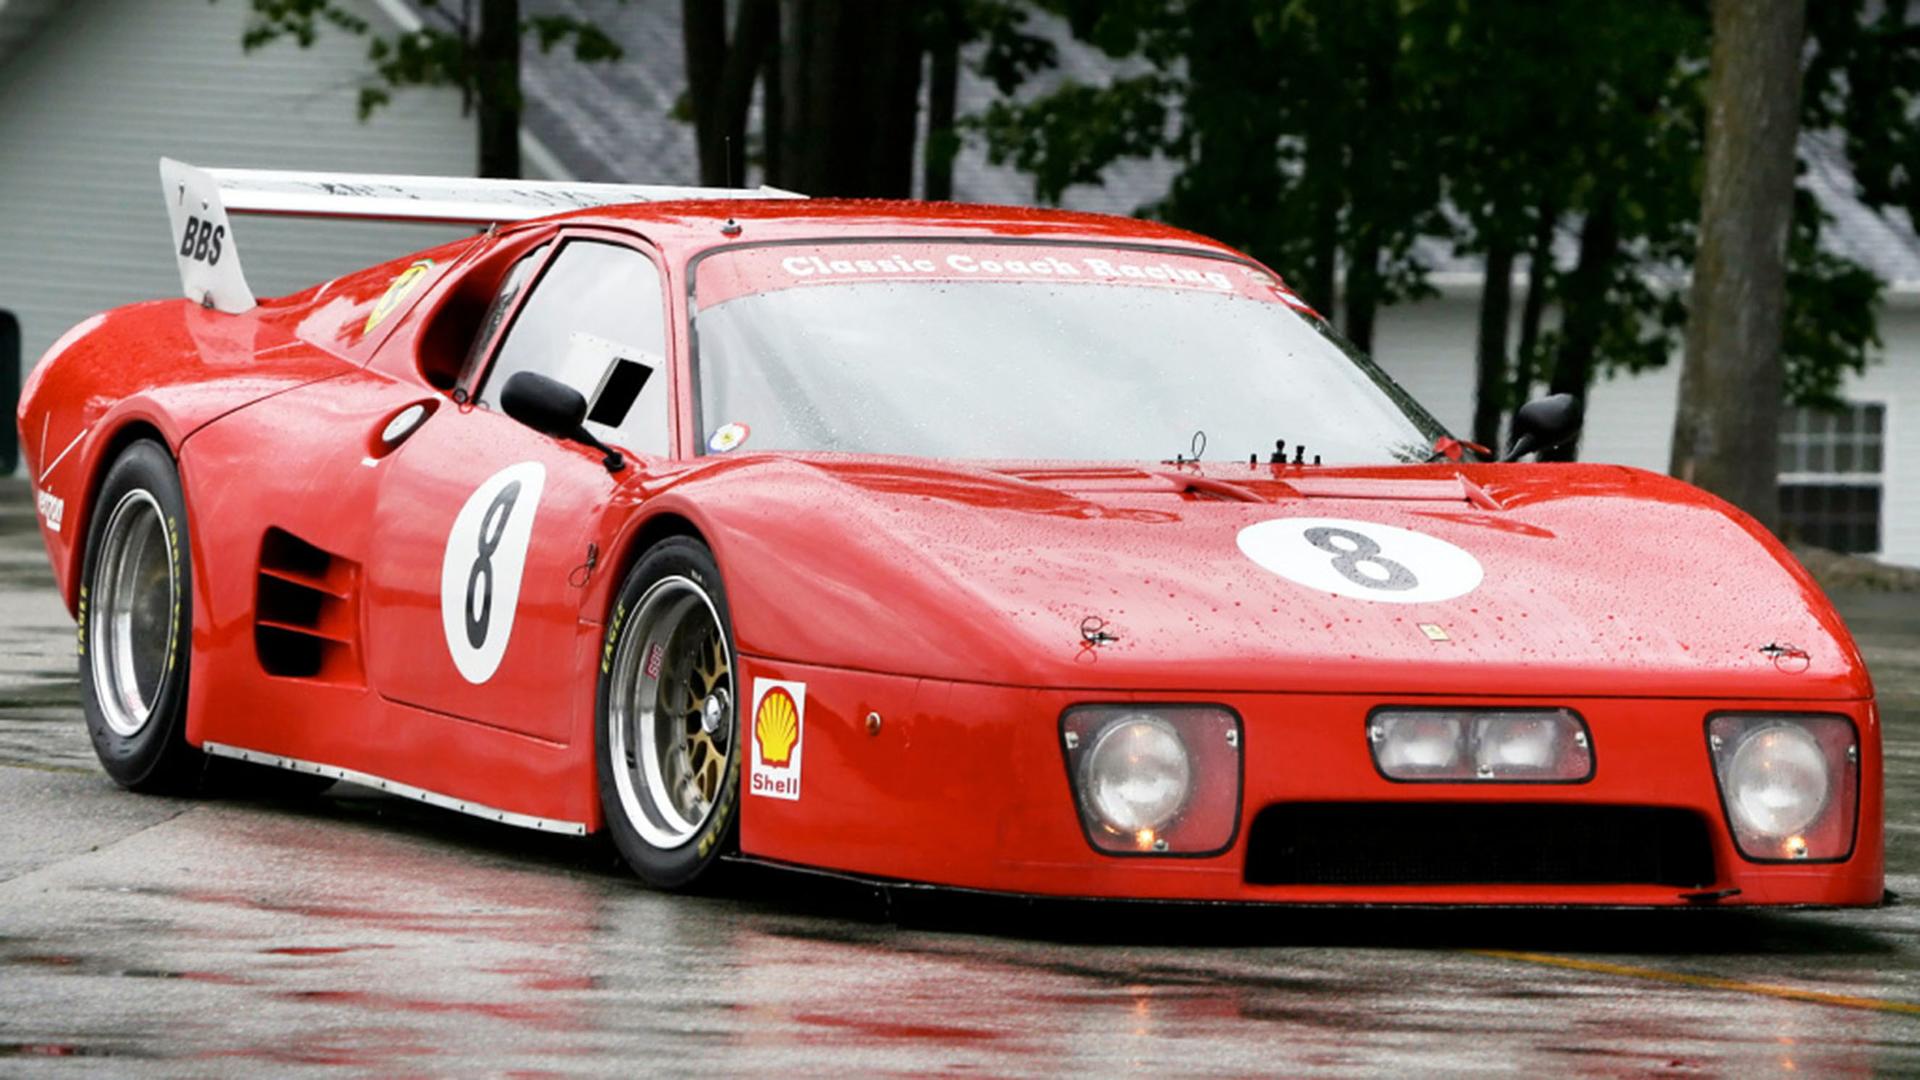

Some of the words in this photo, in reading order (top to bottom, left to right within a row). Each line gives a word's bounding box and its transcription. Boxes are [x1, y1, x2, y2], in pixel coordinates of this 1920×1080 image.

[180, 216, 224, 267] BBS
[782, 254, 936, 276] Classic
[946, 254, 1080, 275] Coach
[1083, 258, 1232, 290] Racing
[465, 480, 522, 649] 8
[1303, 526, 1419, 591] 8
[753, 772, 798, 795] Shell
